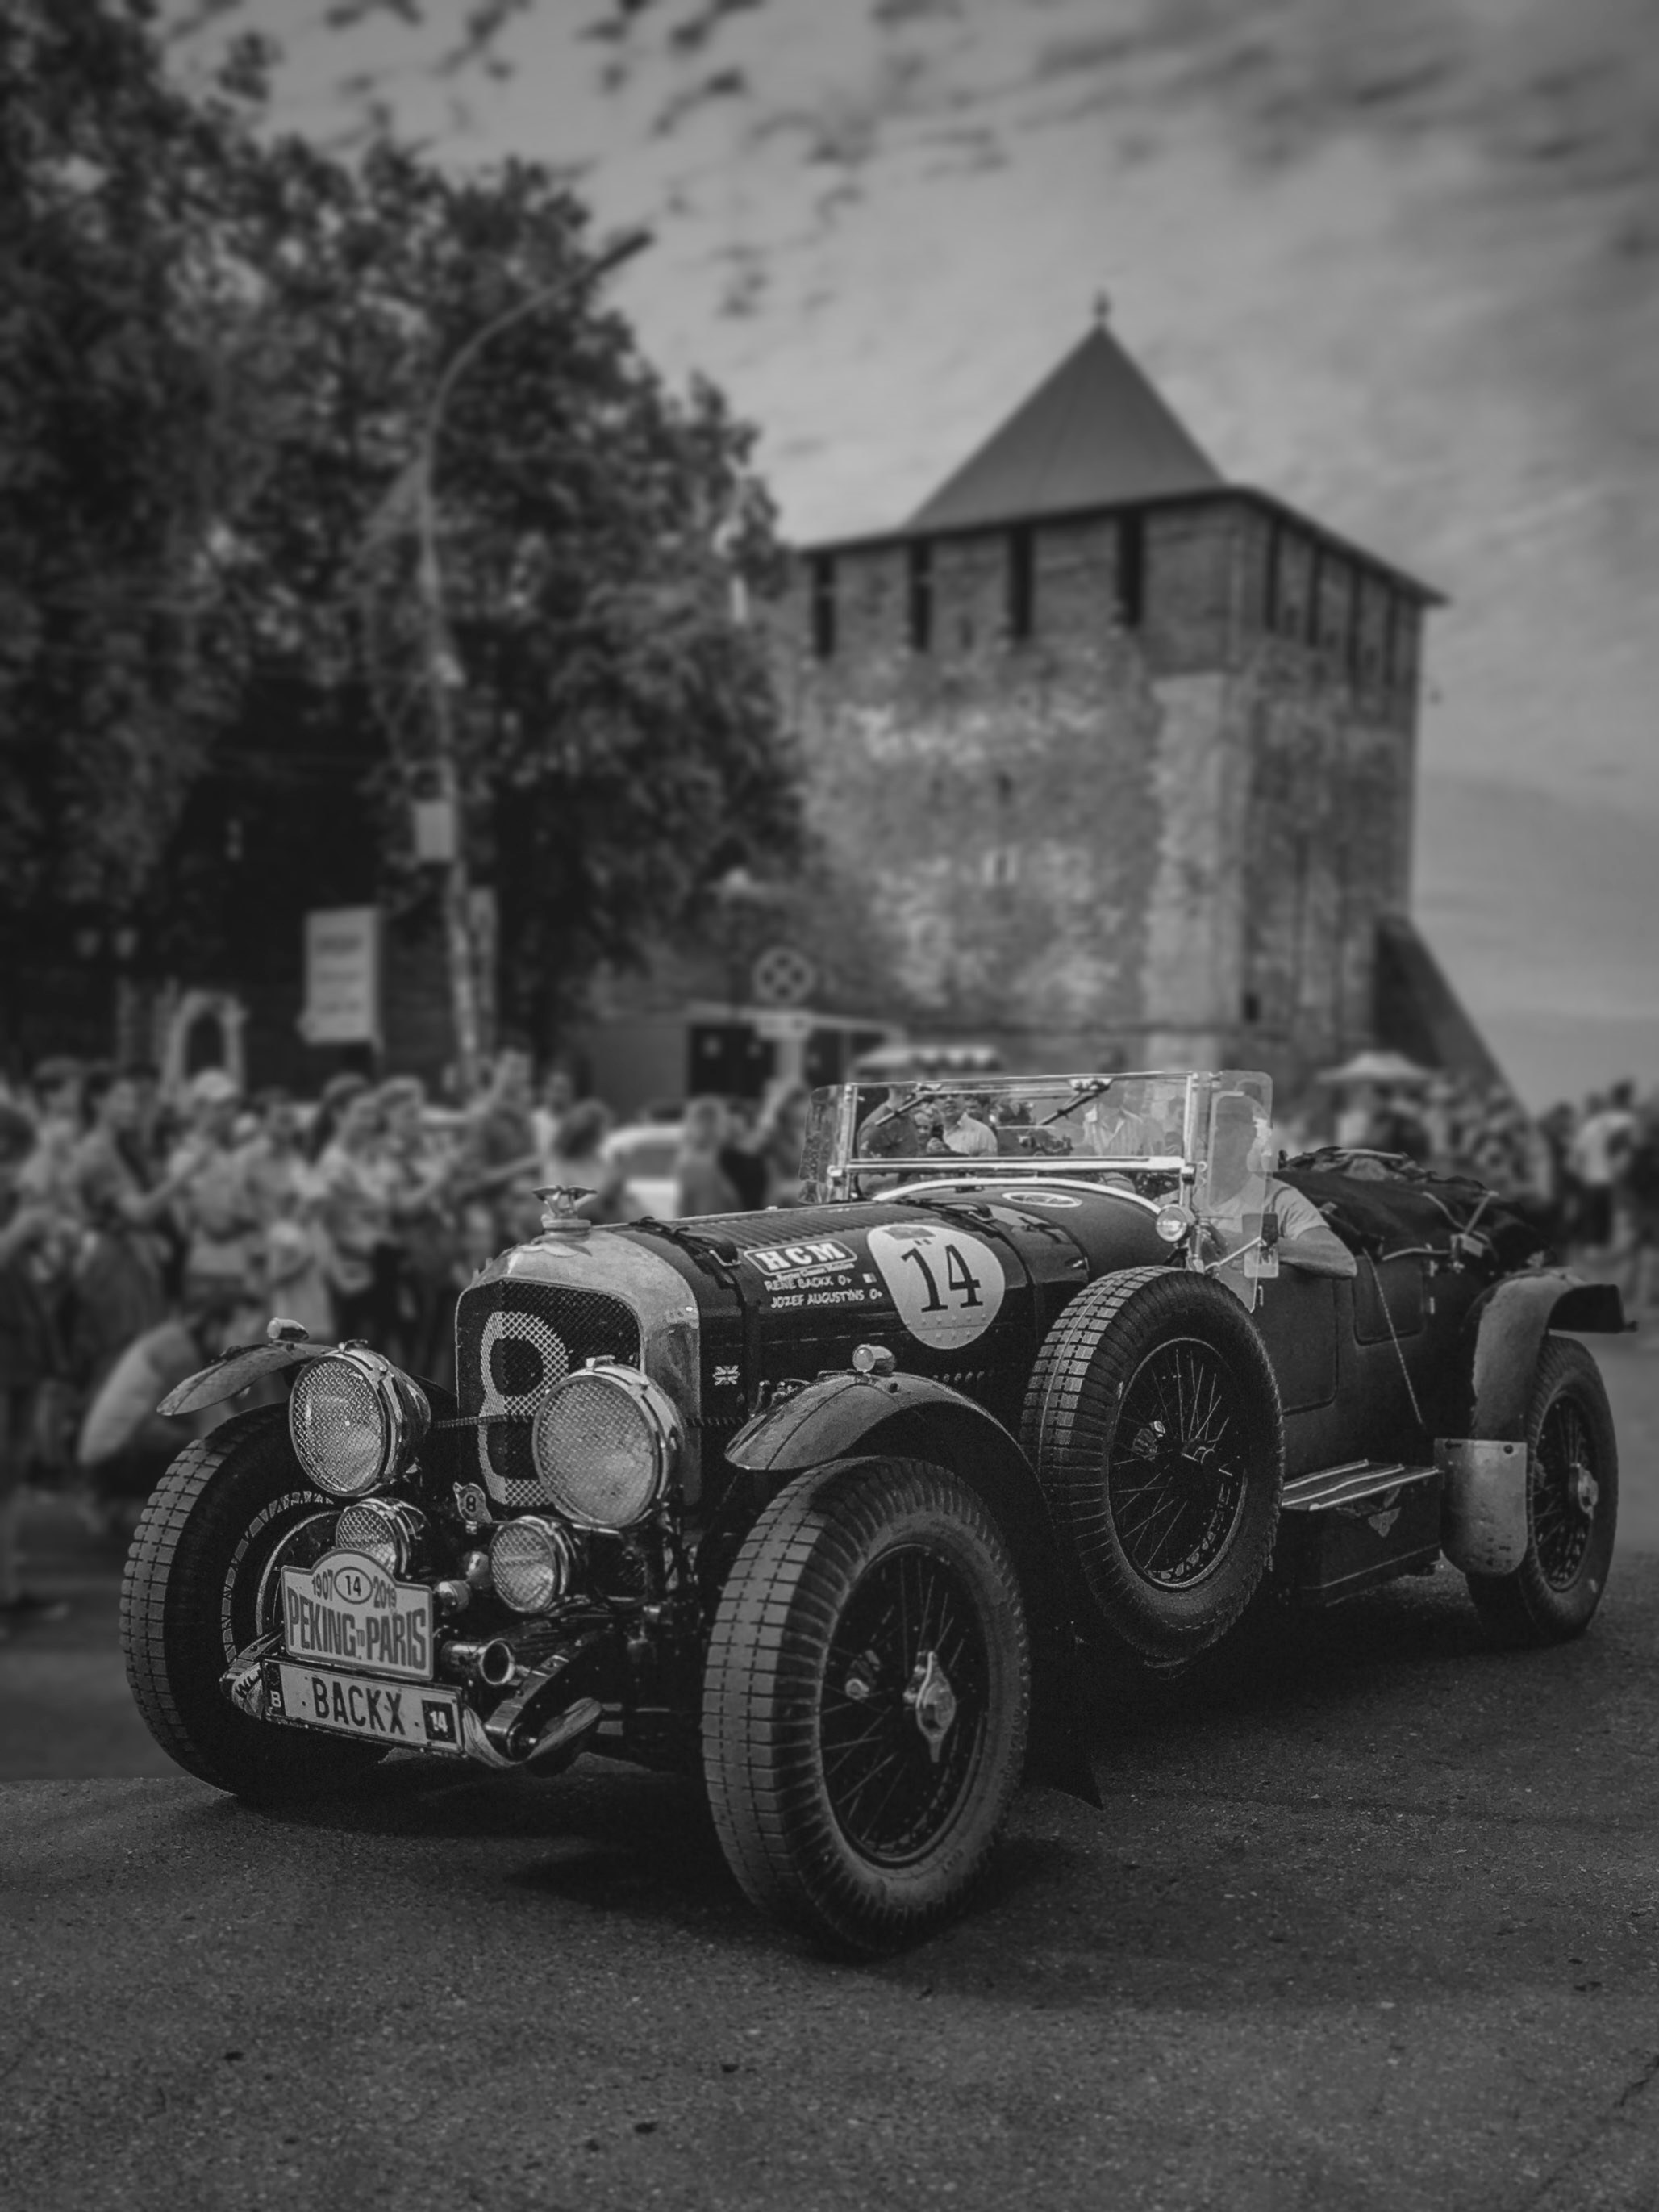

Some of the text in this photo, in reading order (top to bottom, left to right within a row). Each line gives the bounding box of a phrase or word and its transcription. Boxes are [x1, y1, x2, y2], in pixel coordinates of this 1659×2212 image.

[755, 1243, 846, 1271] HCM
[900, 1244, 984, 1313] 14
[311, 1569, 398, 1609] 1907 14 2019
[287, 1586, 356, 1657] PEKING
[366, 1608, 427, 1670] PARIS
[269, 1691, 282, 1709] B
[311, 1677, 406, 1735] BACKX
[429, 1710, 448, 1733] 14
